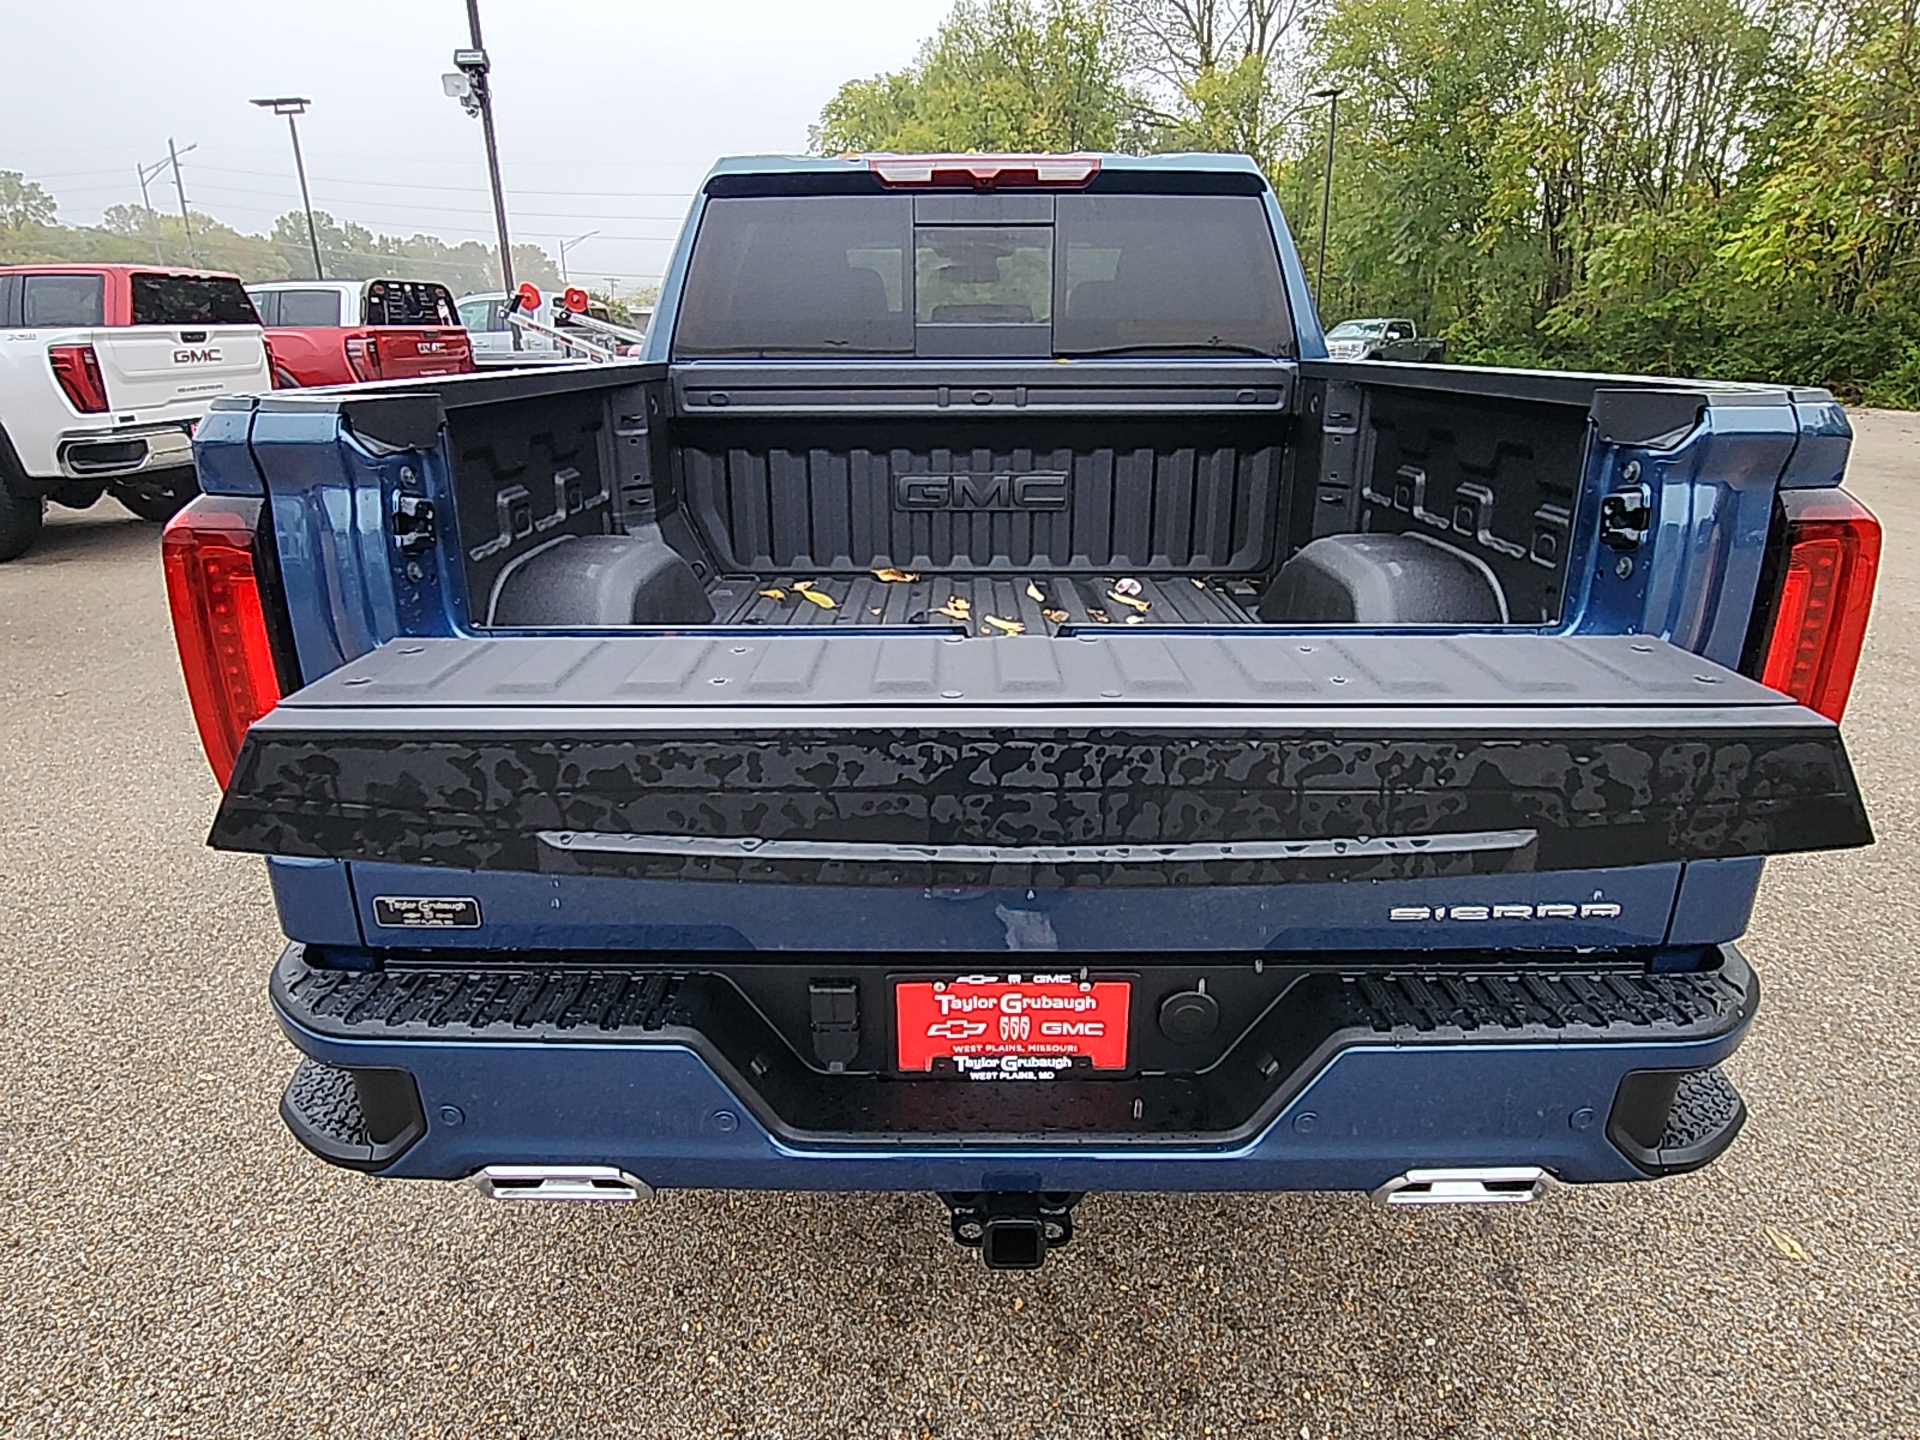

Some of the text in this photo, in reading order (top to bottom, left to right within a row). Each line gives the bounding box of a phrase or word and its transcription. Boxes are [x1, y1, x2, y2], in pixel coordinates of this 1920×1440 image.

[173, 348, 223, 364] GMC
[899, 475, 1066, 508] GMC
[1389, 903, 1621, 921] SIERRA
[1033, 975, 1072, 983] GMC
[934, 993, 1097, 1015] Taylor Grubaugh
[1041, 1022, 1104, 1036] GMC
[953, 1044, 1078, 1053] WEST PLAINS, MISSOURI
[953, 1056, 1072, 1072] Taylor Grubaugh
[970, 1071, 1055, 1080] WEST PLAINS, MO
